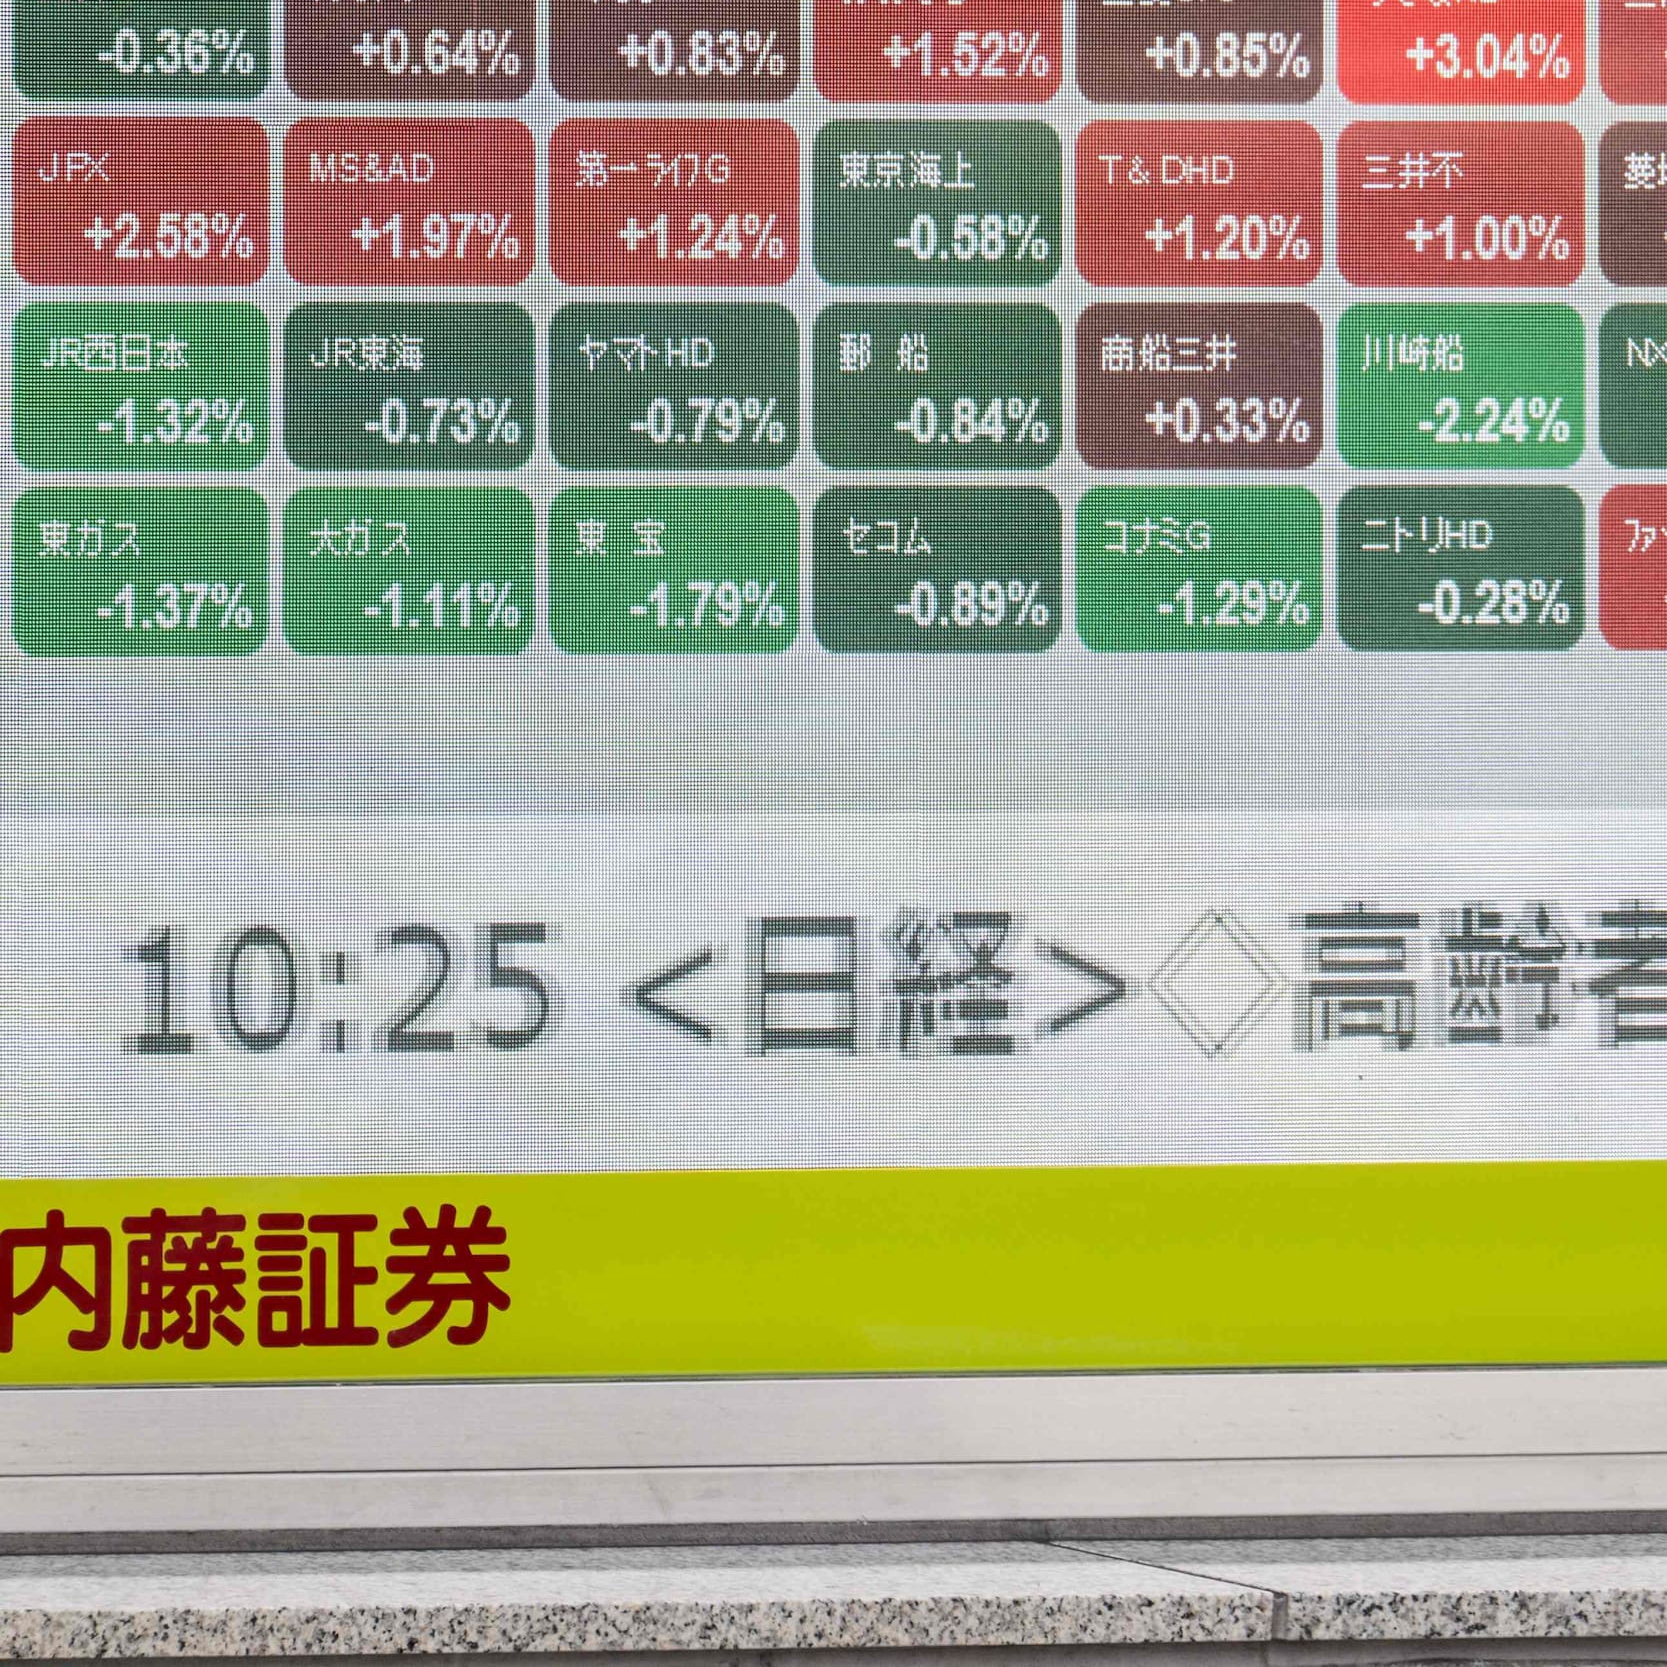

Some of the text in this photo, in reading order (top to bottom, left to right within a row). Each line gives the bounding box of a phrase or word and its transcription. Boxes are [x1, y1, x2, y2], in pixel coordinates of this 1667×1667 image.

[97, 26, 256, 76] -0.36%
[352, 27, 522, 77] +0.64%
[618, 28, 786, 77] +0.83%
[883, 30, 1051, 79] +1.52%
[1145, 30, 1312, 80] +0.85%
[1405, 31, 1572, 80] +3.04%
[307, 152, 435, 184] MS&AD
[838, 150, 975, 190] 東京海上
[83, 211, 255, 260] +2.58%
[351, 211, 521, 260] +1.97%
[618, 212, 786, 261] +1.24%
[894, 213, 1048, 261] -0.58%
[1144, 213, 1311, 262] +1.20%
[1405, 213, 1571, 262] +1.00%
[40, 332, 188, 373] JR西日本
[308, 334, 425, 372] JR東海
[96, 396, 255, 446] -1.32%
[364, 396, 521, 445] -0.73%
[630, 396, 786, 445] -0.79%
[894, 396, 1050, 445] -0.84%
[1144, 395, 1312, 444] +0.33%
[1417, 395, 1571, 445] -2.24%
[841, 519, 933, 556] セコム
[1103, 516, 1213, 555] コナミG
[96, 581, 254, 631] -1.37%
[363, 581, 520, 629] -1.11%
[629, 579, 785, 629] -1.79%
[894, 579, 1050, 628] -0.89%
[1157, 578, 1311, 628] -1.29%
[1417, 578, 1571, 627] -0.28%
[122, 921, 563, 1056] 10:25
[0, 1203, 512, 1354] 内藤証券
